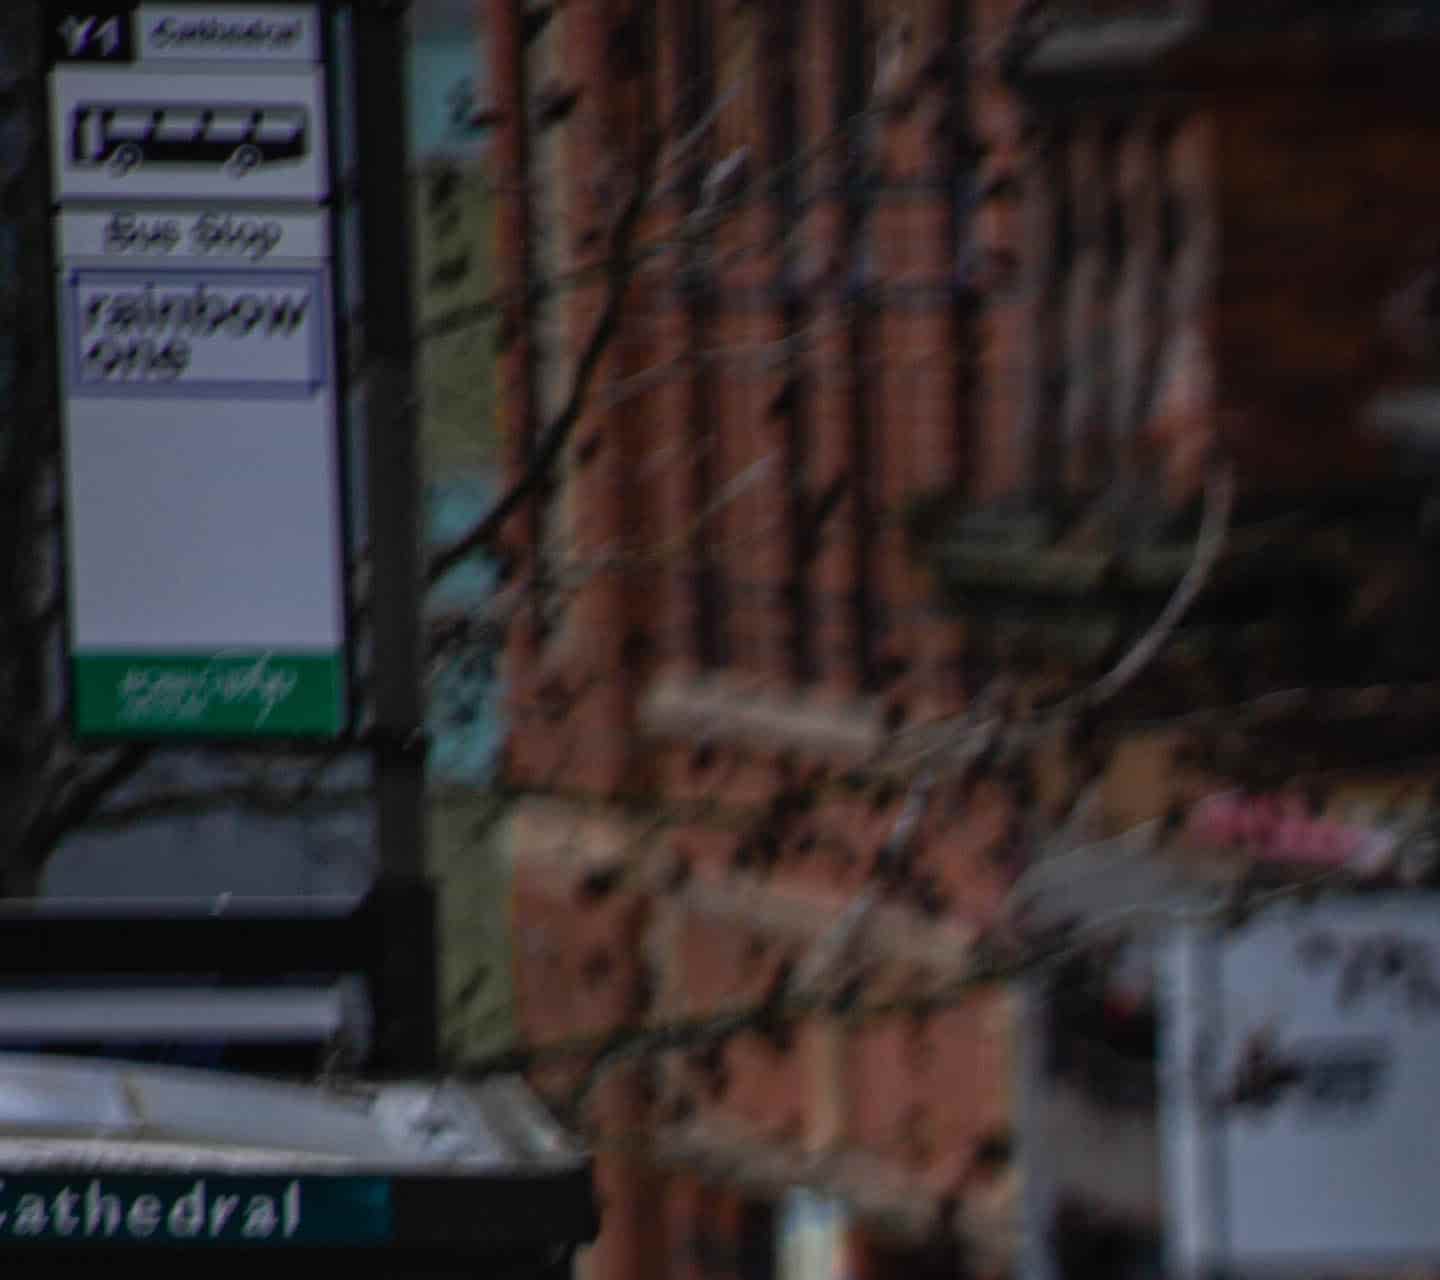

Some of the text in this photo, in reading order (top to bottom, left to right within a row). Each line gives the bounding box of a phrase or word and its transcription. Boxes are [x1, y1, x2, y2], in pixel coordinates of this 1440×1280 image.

[104, 210, 283, 260] Bus Stop
[84, 282, 311, 335] rainbow
[82, 338, 192, 380] one
